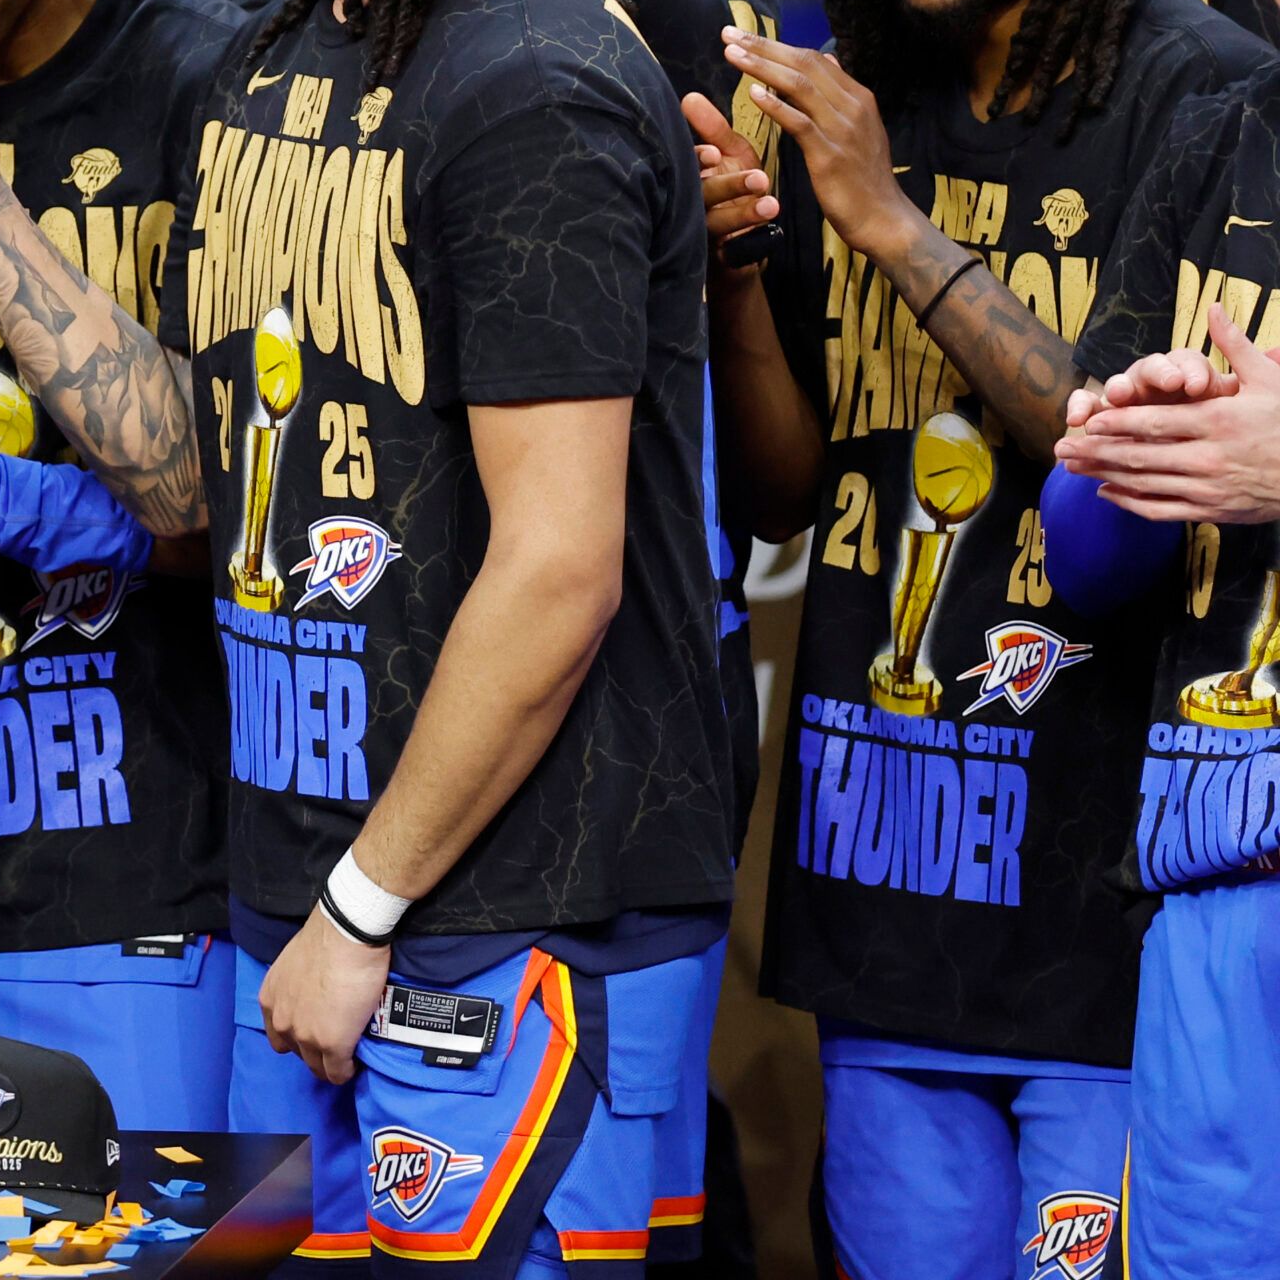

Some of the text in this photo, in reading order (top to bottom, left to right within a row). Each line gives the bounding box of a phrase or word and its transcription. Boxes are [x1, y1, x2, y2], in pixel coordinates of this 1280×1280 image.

[280, 73, 335, 140] NBA
[928, 174, 1009, 246] NBA
[1033, 195, 1090, 226] Finals
[318, 400, 376, 500] 25
[310, 534, 372, 586] OKC
[38, 569, 109, 624] OKC
[295, 618, 368, 653] CITY
[24, 651, 117, 687] CITY
[986, 639, 1045, 690] OKC
[963, 724, 1035, 758] CITY
[796, 727, 1029, 907] THUNDER
[393, 1001, 405, 1013] 50
[411, 994, 456, 1007] ENGINEERED
[374, 1152, 428, 1194] OKC
[1038, 1211, 1109, 1264] OKC
